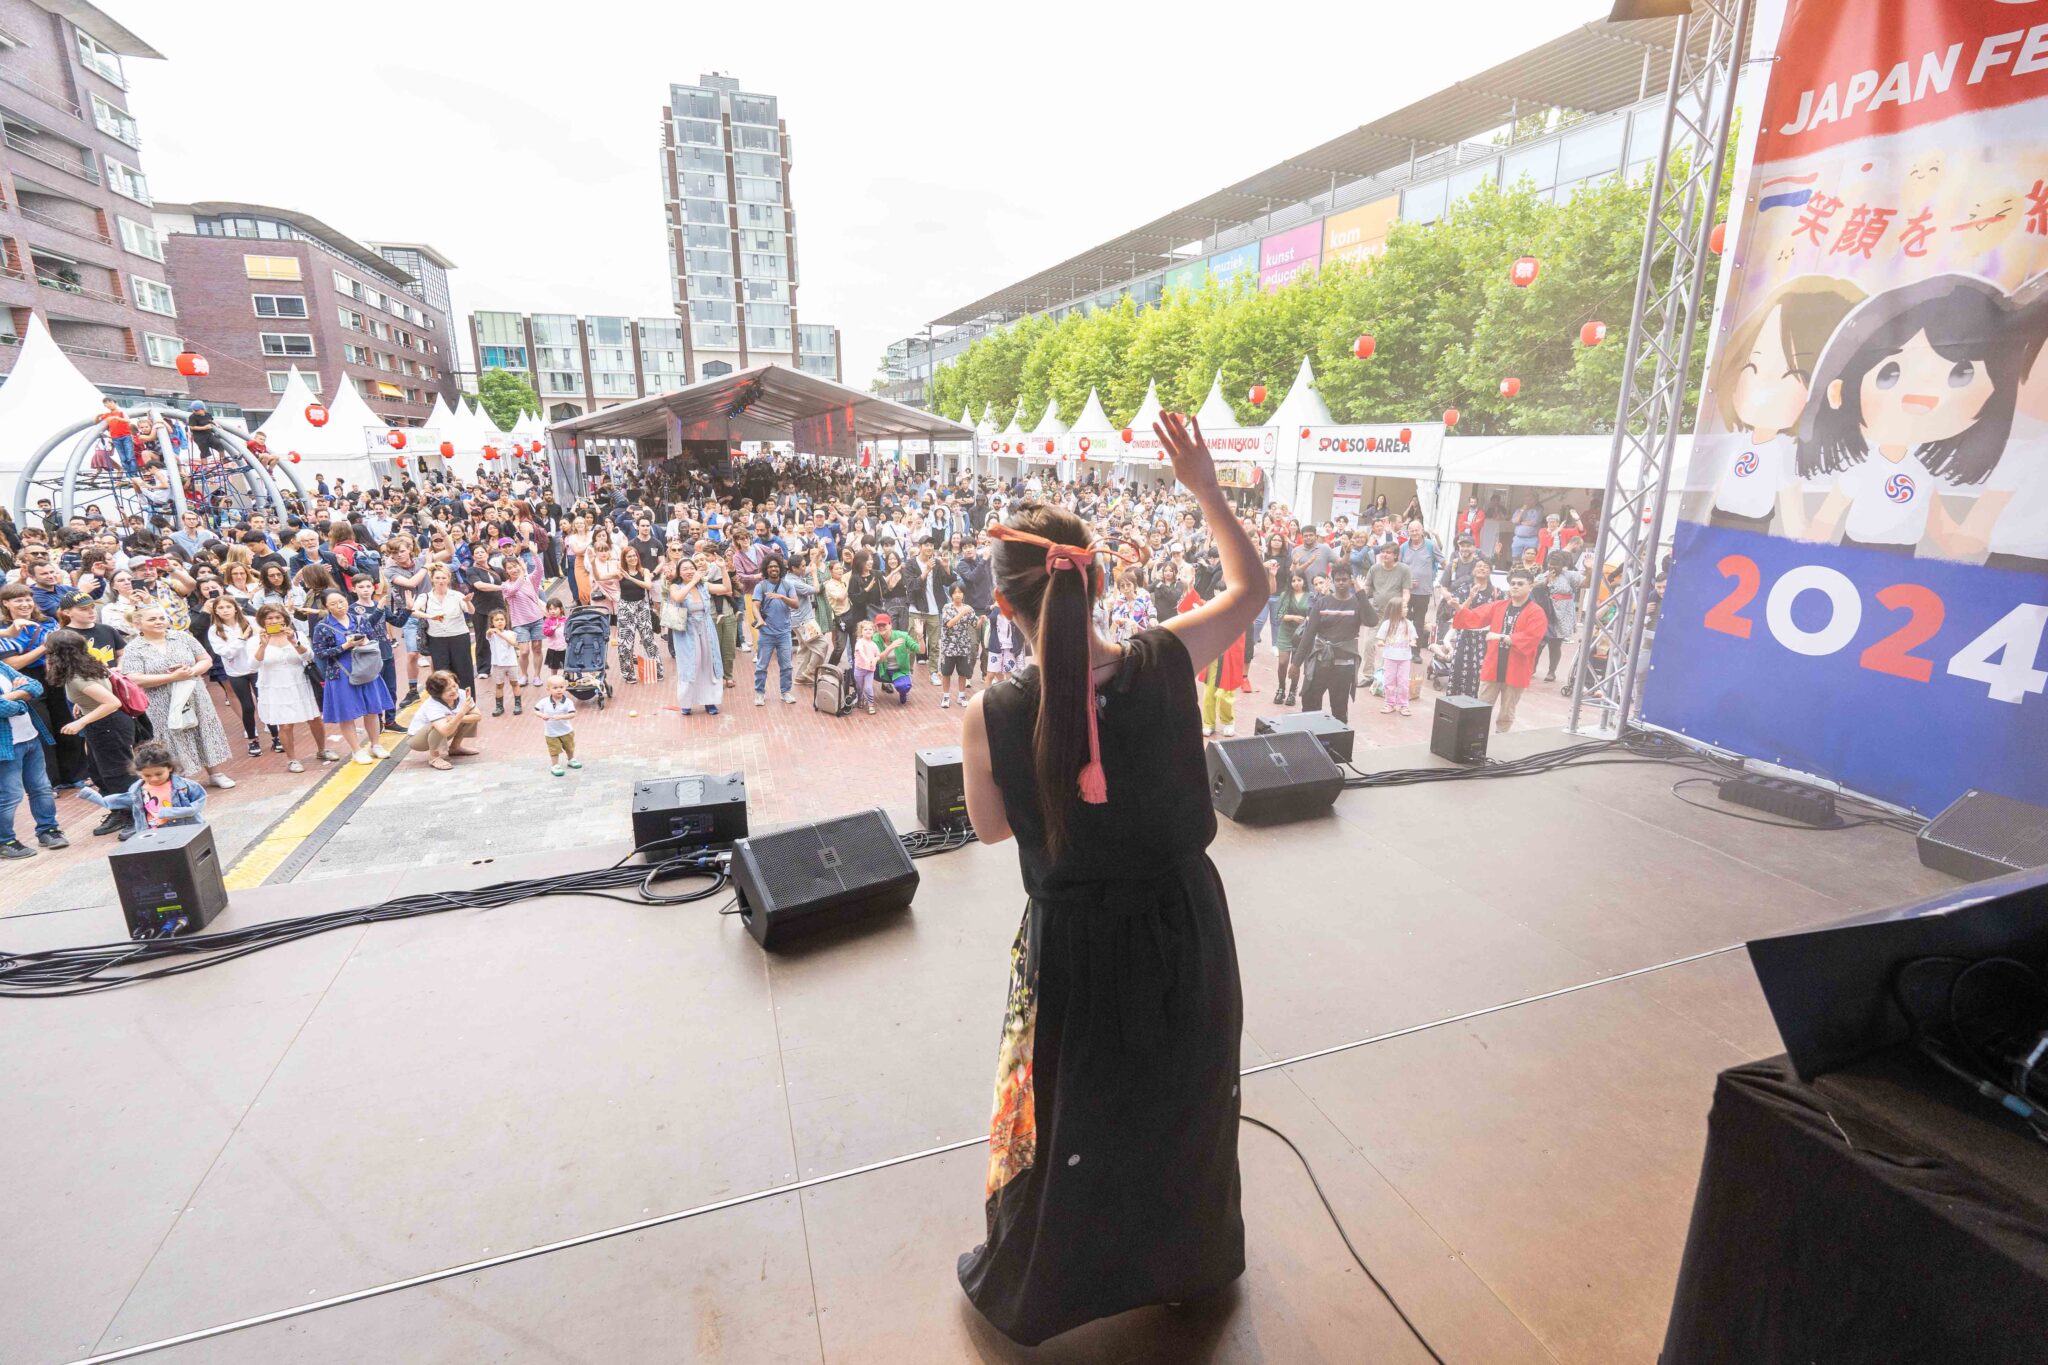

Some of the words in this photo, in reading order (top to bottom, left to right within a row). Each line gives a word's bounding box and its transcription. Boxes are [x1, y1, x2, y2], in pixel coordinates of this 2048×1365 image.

[1779, 43, 1964, 136] JAPAN
[1266, 247, 1295, 268] kunst
[1330, 227, 1360, 249] kom
[1704, 554, 2048, 704] 2024
